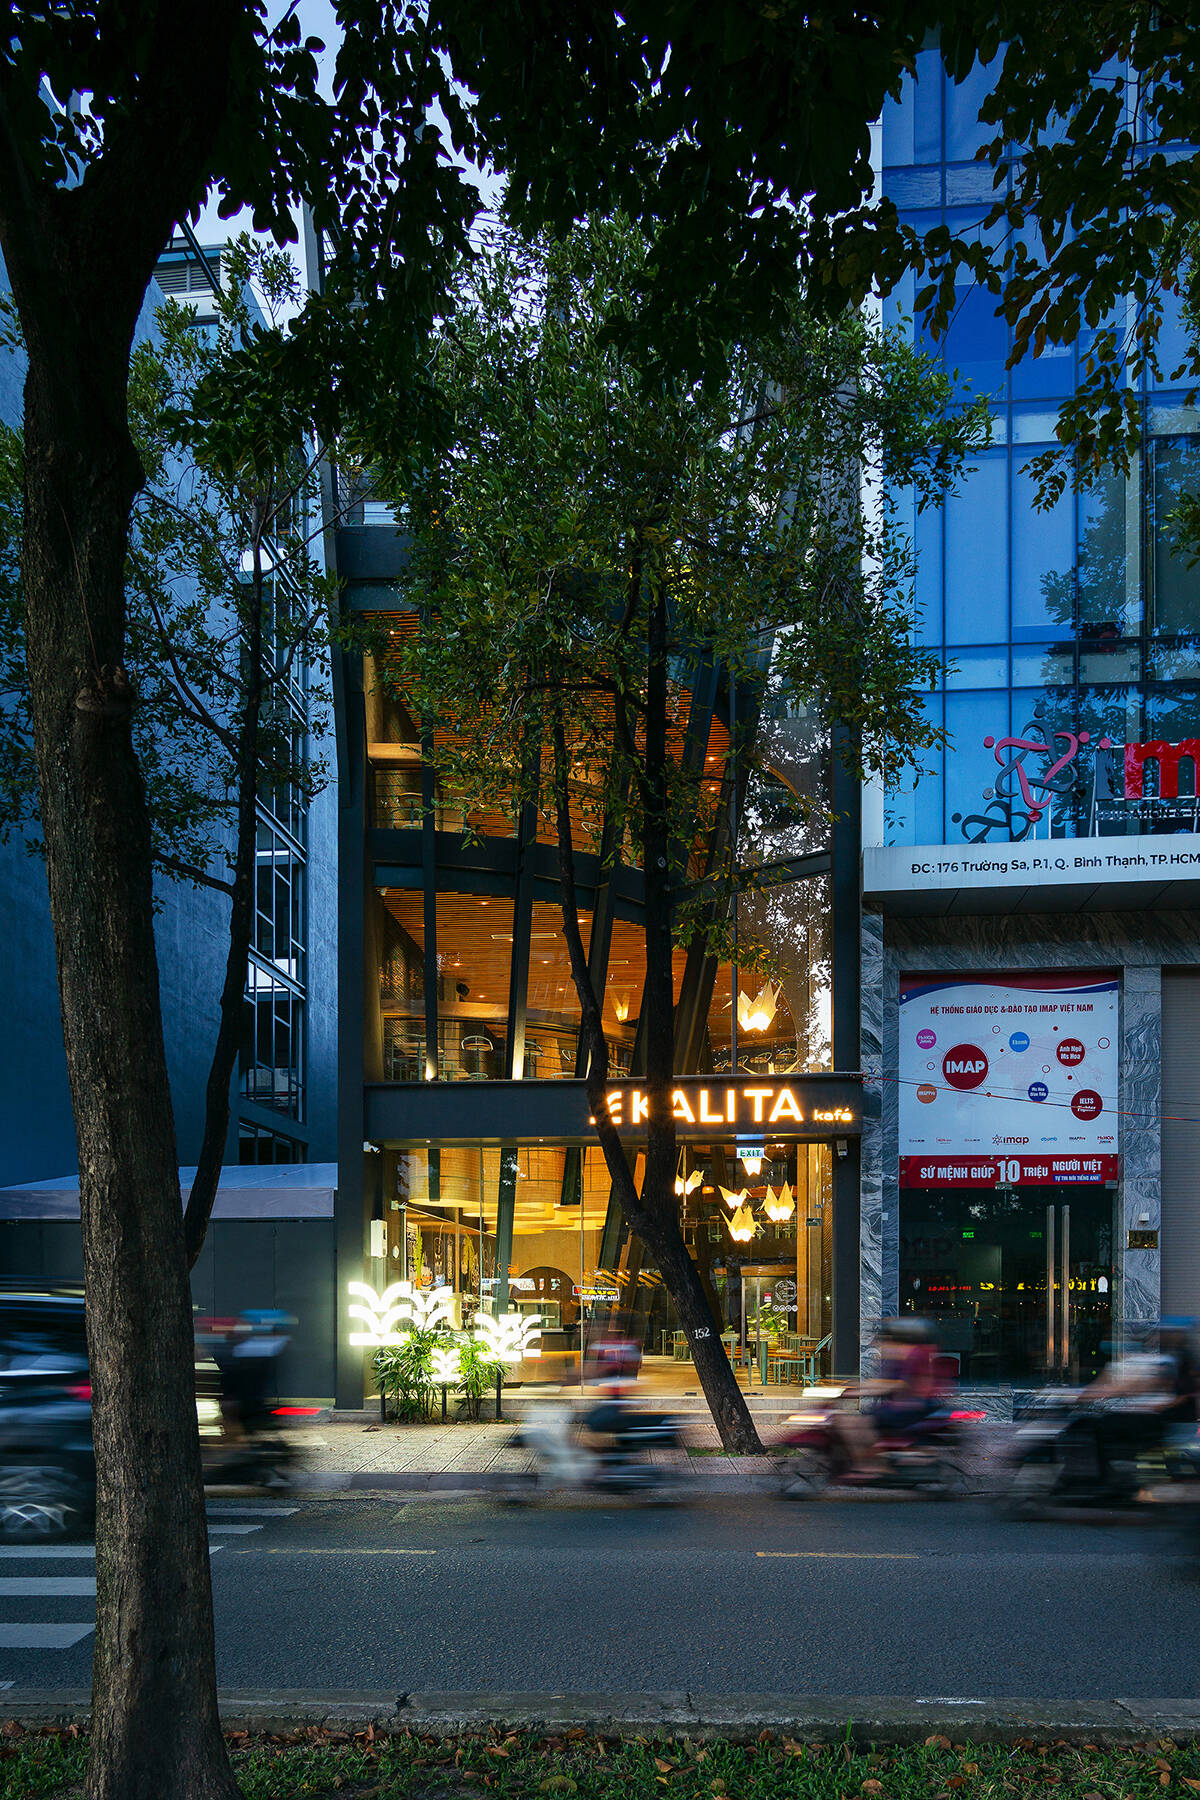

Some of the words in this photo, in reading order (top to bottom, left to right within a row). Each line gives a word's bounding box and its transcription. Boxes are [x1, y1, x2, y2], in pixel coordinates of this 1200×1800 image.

[961, 859, 1008, 873] Trường
[1011, 859, 1030, 871] Sa,
[1054, 858, 1070, 870] Q.
[1073, 856, 1102, 868] Bình
[1105, 854, 1148, 868] Thạnh,
[966, 1004, 983, 1014] GIÁO
[984, 1005, 999, 1015] DỤC
[1024, 1004, 1038, 1014] TẠO
[1039, 1004, 1058, 1013] IMAP
[1059, 1003, 1075, 1013] VIỆT
[1076, 1003, 1094, 1012] NAM
[945, 1060, 986, 1074] IMAP
[1079, 1097, 1094, 1105] IELTS
[1003, 1135, 1030, 1146] imap
[740, 1149, 761, 1157] EXIT
[920, 1164, 937, 1179] SỨ
[937, 1164, 968, 1181] MỆNH
[970, 1164, 996, 1179] GIÚP
[996, 1159, 1021, 1183] 10
[1023, 1164, 1048, 1179] TRIỆU
[1052, 1158, 1081, 1172] NGƯỜI
[1082, 1158, 1102, 1173] VIỆT
[692, 1326, 711, 1339] 152
